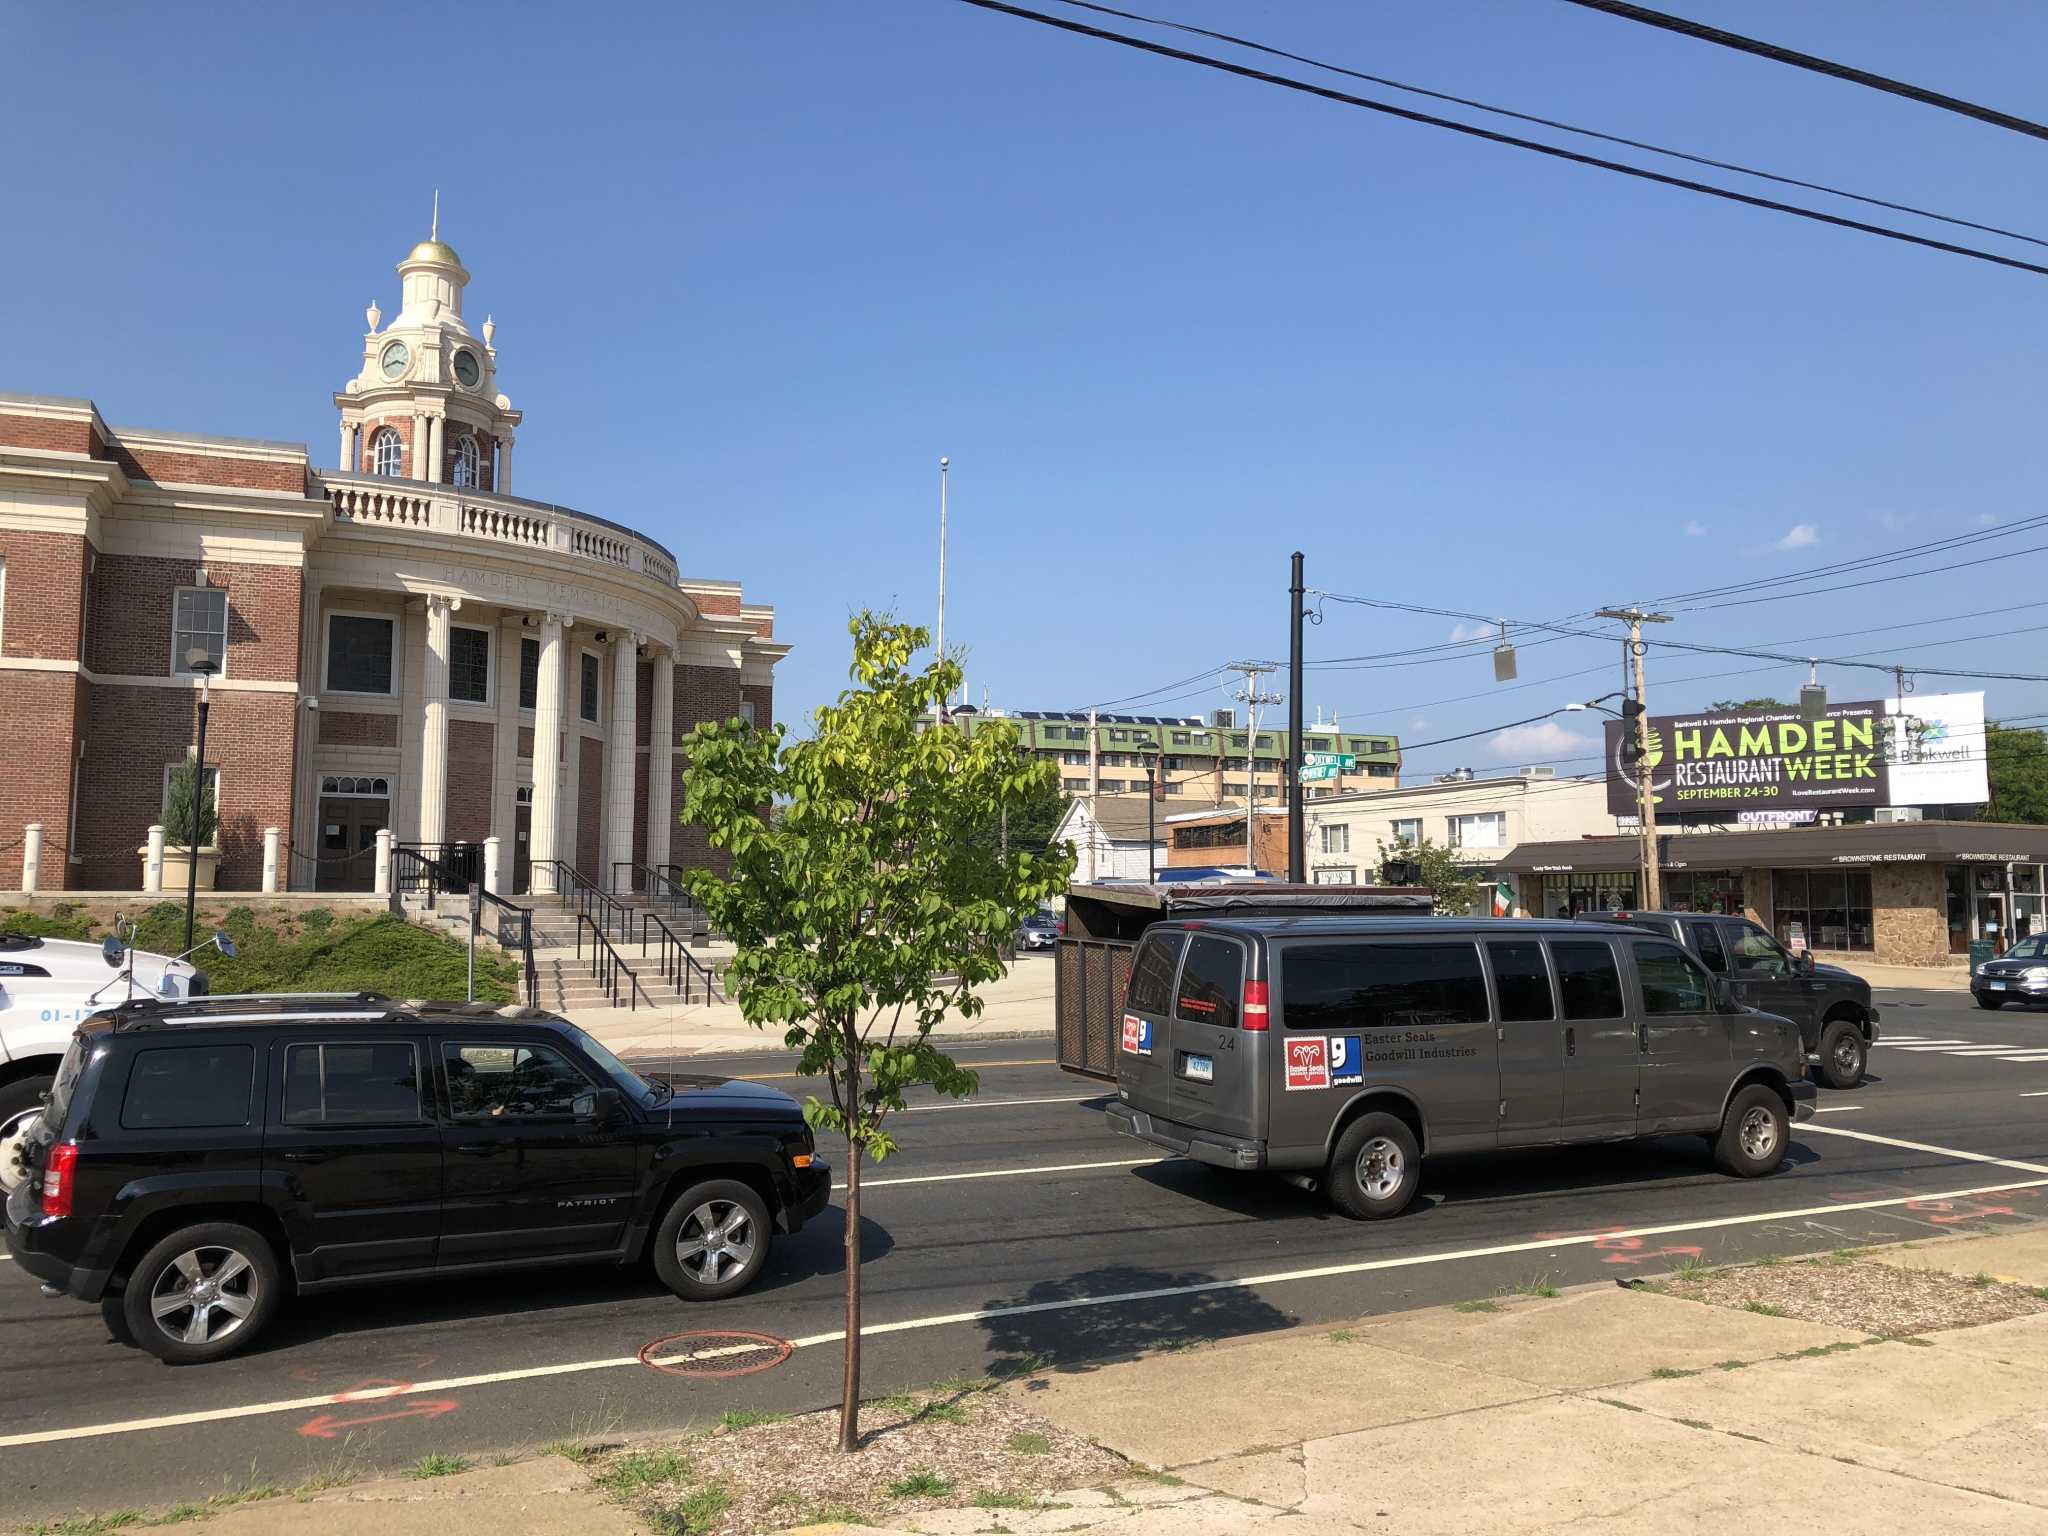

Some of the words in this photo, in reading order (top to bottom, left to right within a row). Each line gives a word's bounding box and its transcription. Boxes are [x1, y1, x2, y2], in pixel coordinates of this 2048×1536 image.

[1674, 720, 1701, 728] Bankwell
[1709, 718, 1735, 726] Hamden
[1737, 715, 1764, 724] Regional
[1765, 712, 1794, 721] Chamber
[1674, 718, 1873, 760] HAMDEN
[1901, 745, 1970, 762] Bnkwell
[1344, 758, 1354, 768] AVE
[1675, 757, 1782, 787] RESTAURANT
[1783, 753, 1877, 782] WEEK
[1676, 787, 1741, 801] SEPTEMBER
[1743, 785, 1778, 798] 24-30
[1740, 810, 1813, 822] OUTFRONT
[1838, 854, 1882, 863] BROWNSTONE
[1883, 853, 1927, 862] RESTAURANT
[1961, 853, 1998, 861] BROWNSTONE
[1998, 854, 2031, 862] RESTAURANT
[1219, 1034, 1235, 1052] 24
[1365, 1032, 1402, 1045] Easter
[1405, 1031, 1436, 1042] Seals
[1366, 1048, 1416, 1062] Goodwill
[1420, 1046, 1478, 1060] Industries
[1333, 1075, 1363, 1086] goodwill
[557, 1198, 617, 1208] PATRIOT
